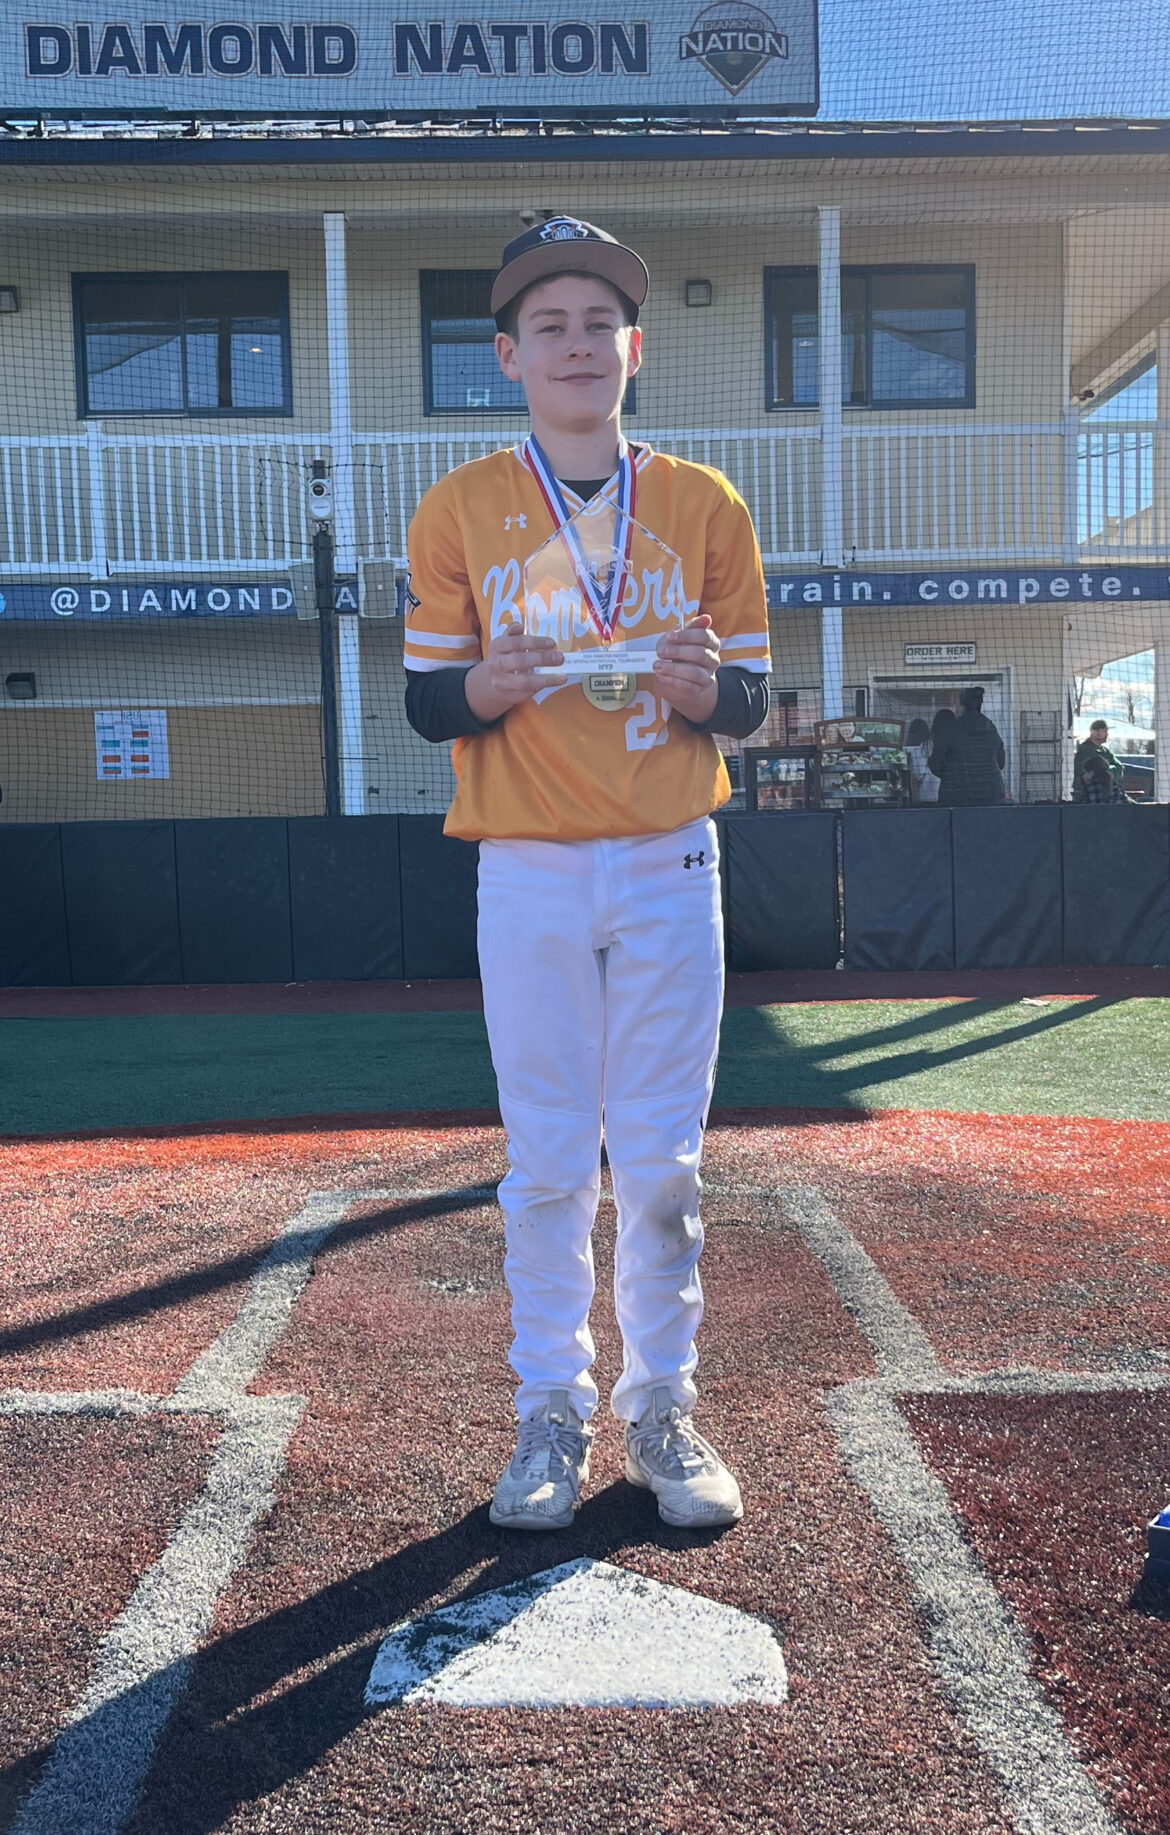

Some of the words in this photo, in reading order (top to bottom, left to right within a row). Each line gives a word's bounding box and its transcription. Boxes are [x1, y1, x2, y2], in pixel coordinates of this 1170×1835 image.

[704, 19, 764, 30] DIAMOND
[25, 22, 357, 77] DIAMOND
[393, 21, 651, 76] NATION
[680, 32, 787, 58] NATION
[482, 557, 700, 645] Bomers
[918, 572, 1141, 604] compete.
[906, 647, 942, 656] ORDER
[946, 646, 974, 655] HERE
